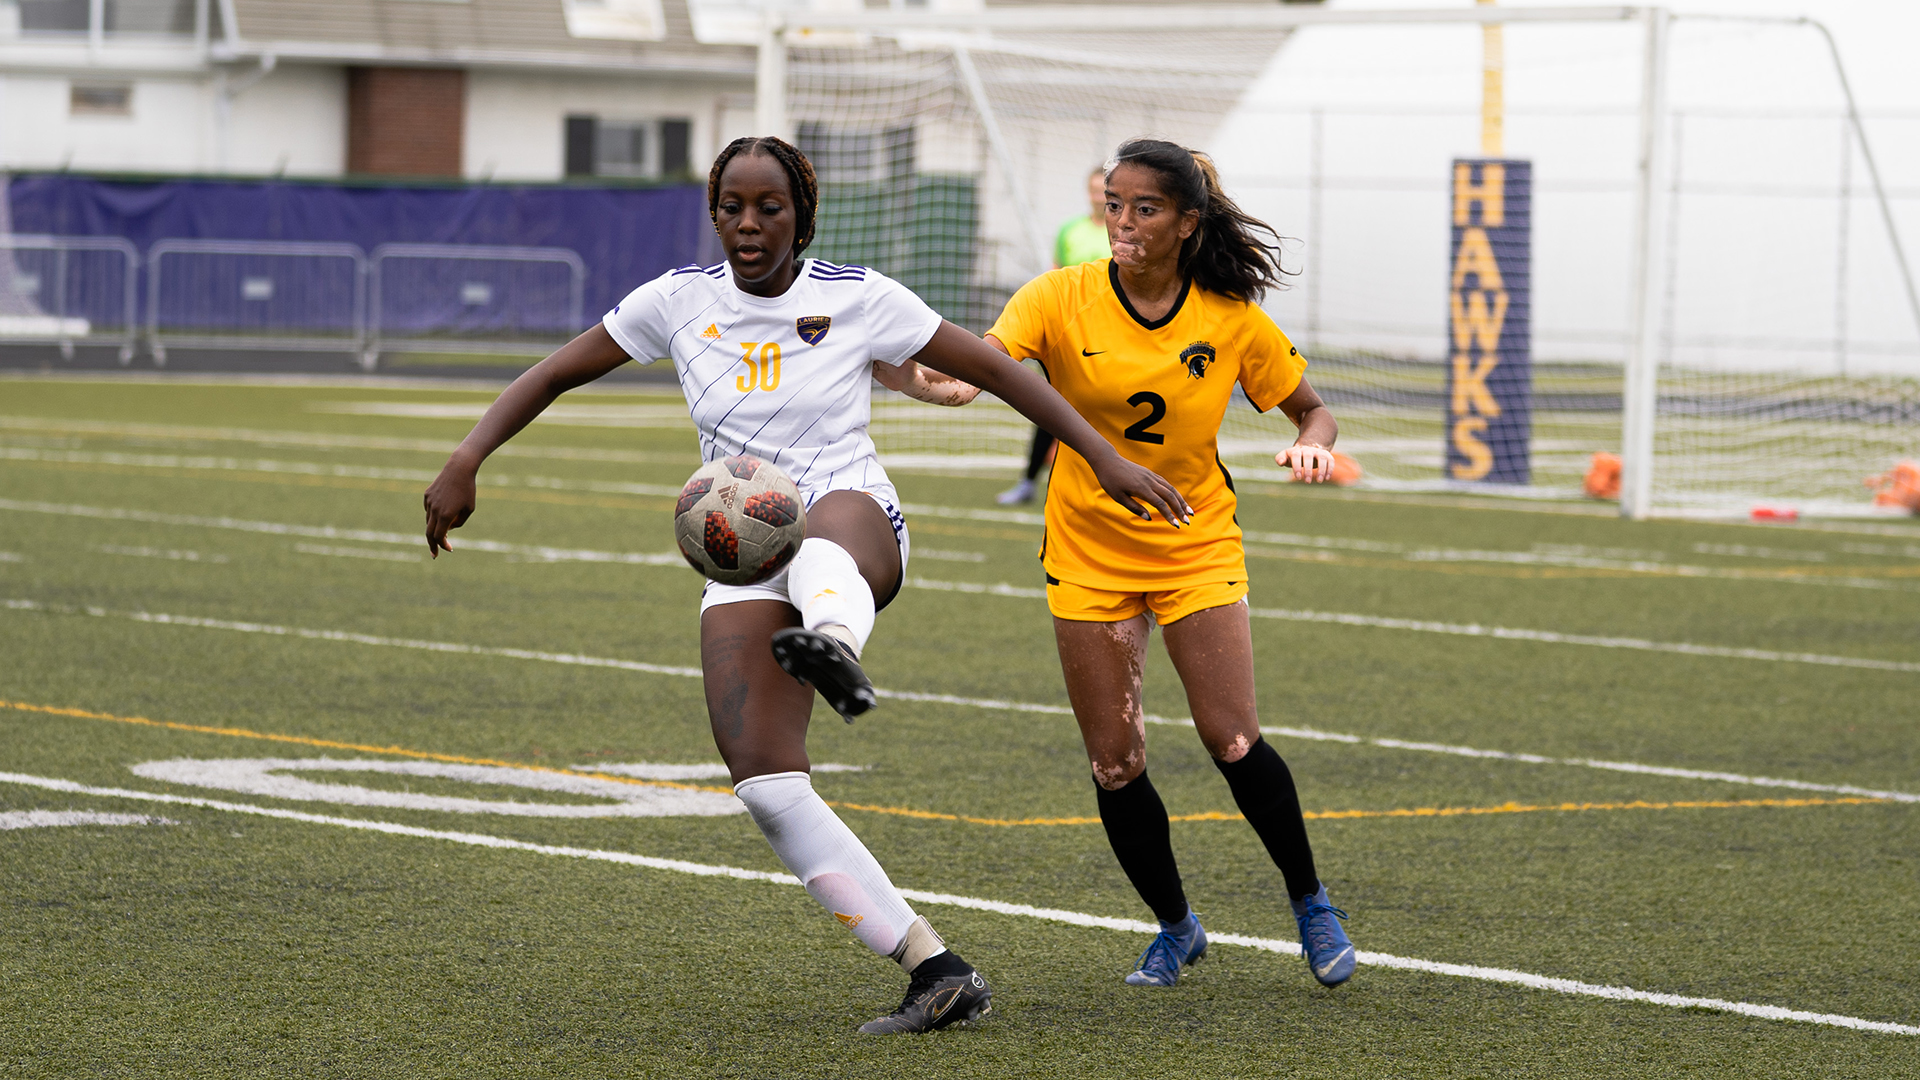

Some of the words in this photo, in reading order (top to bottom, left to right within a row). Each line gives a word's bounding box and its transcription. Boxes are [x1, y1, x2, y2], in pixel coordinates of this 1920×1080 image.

[1450, 162, 1509, 481] HAWKS
[736, 342, 781, 392] 30
[1124, 391, 1166, 445] 2
[727, 482, 739, 509] adidas
